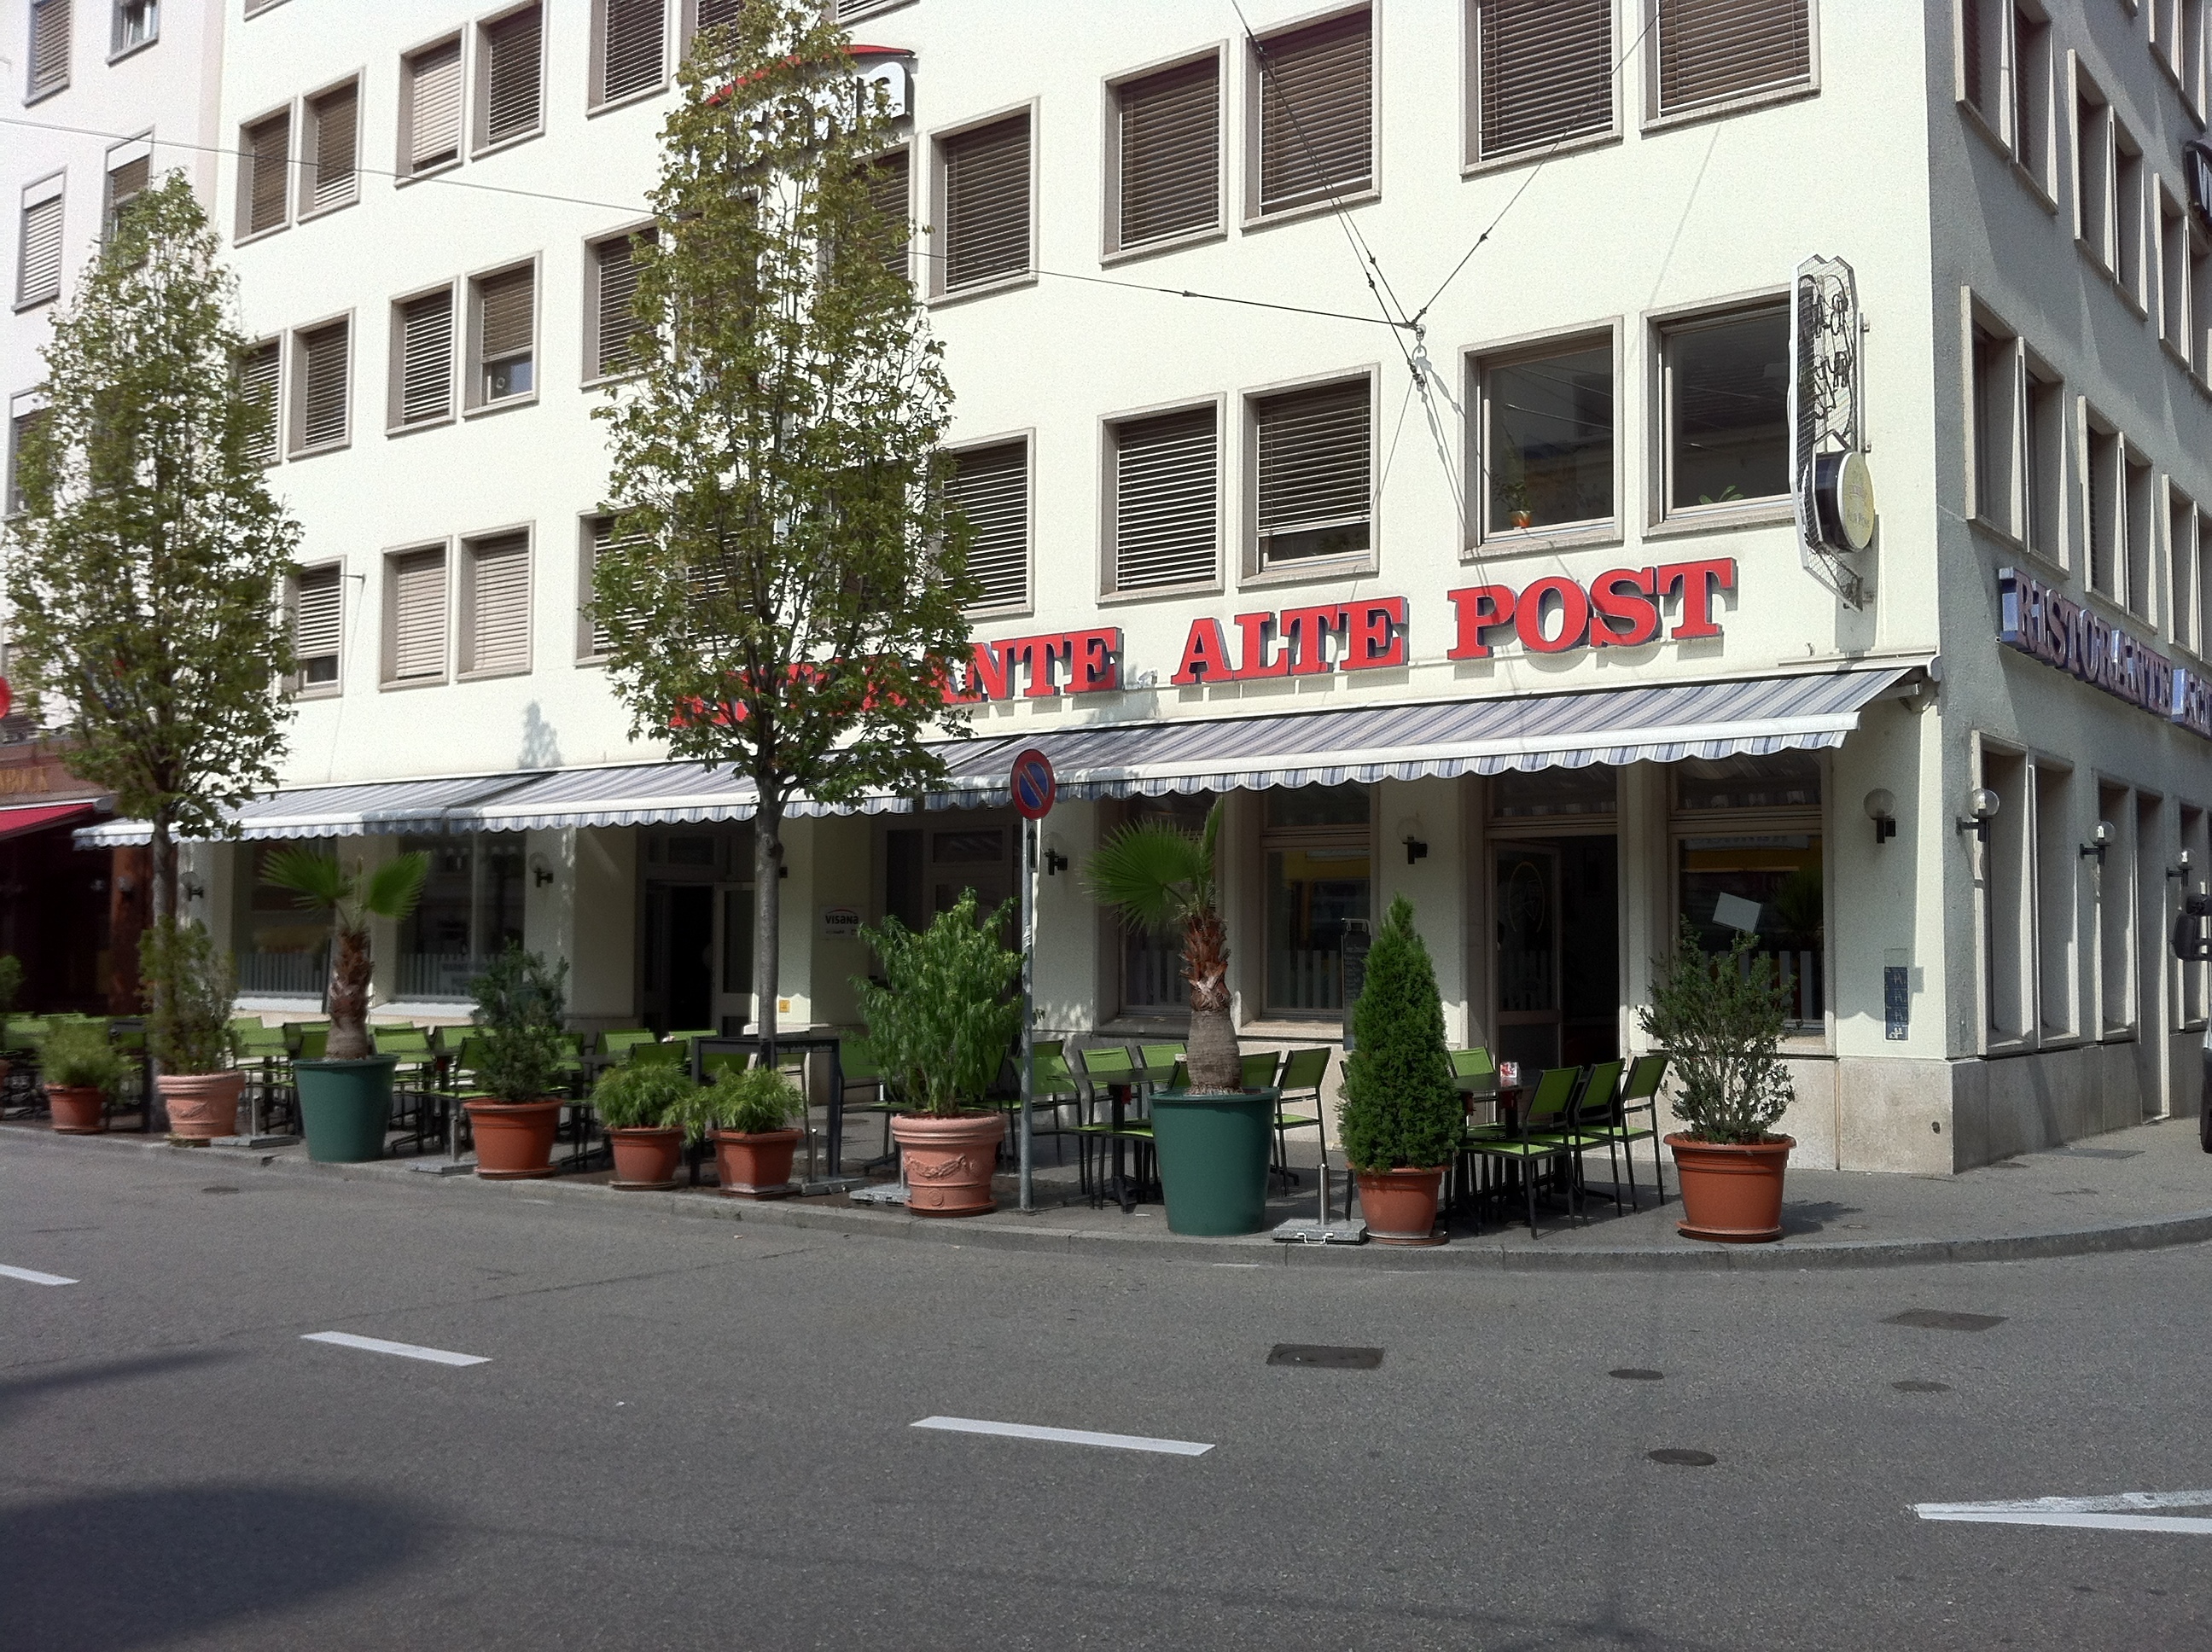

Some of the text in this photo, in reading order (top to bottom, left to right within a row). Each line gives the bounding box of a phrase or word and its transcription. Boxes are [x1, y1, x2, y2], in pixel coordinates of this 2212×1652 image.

[1170, 596, 1408, 685] ALTE
[1447, 556, 1738, 661] POST
[2000, 567, 2173, 720] RISTORANTE
